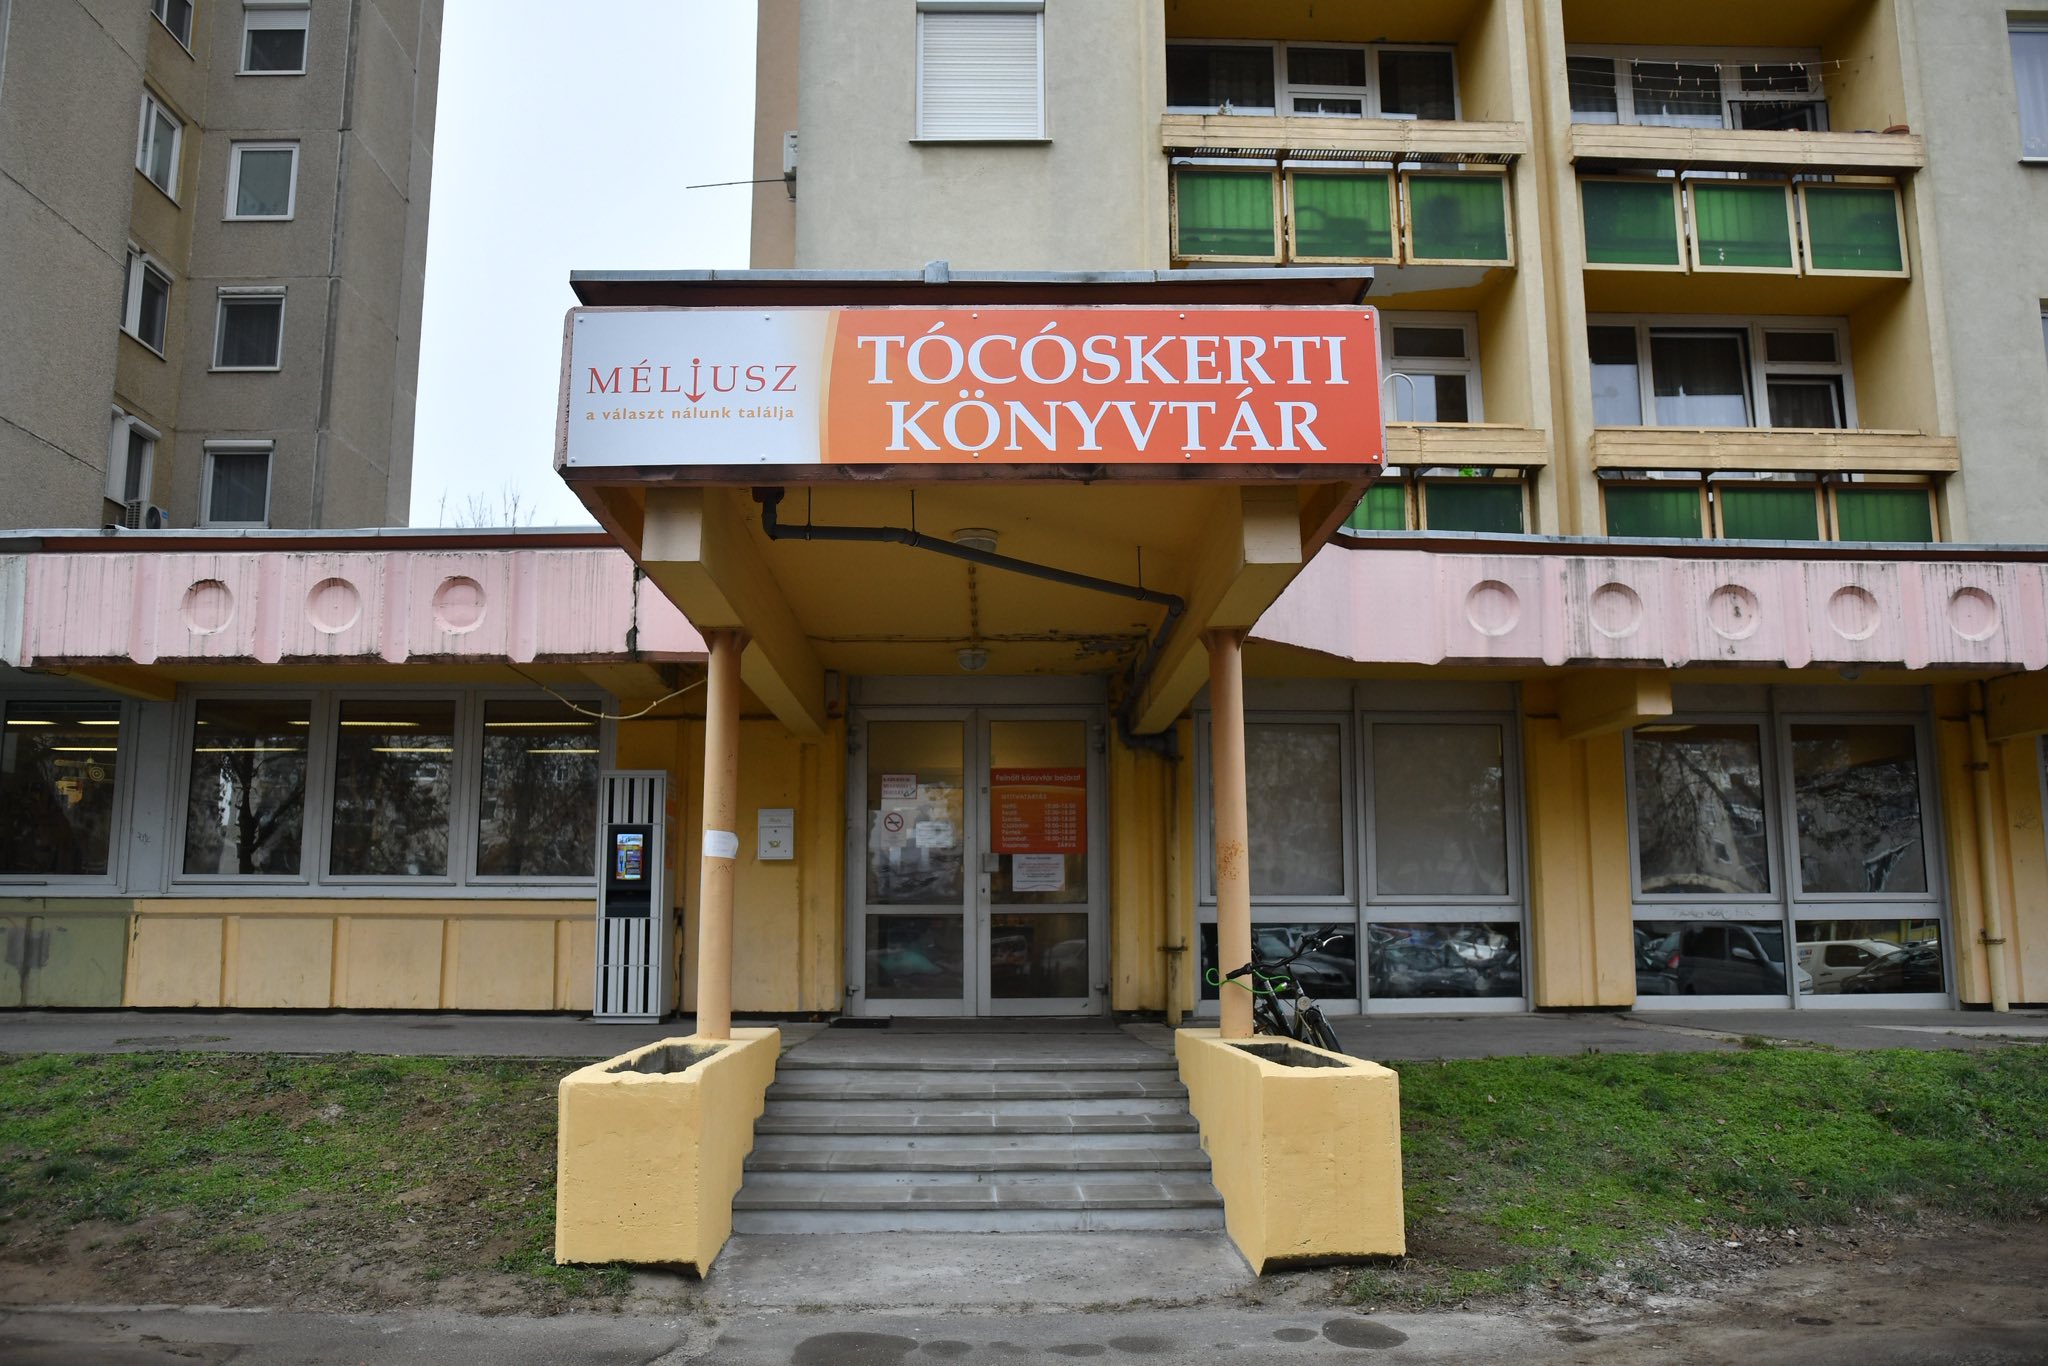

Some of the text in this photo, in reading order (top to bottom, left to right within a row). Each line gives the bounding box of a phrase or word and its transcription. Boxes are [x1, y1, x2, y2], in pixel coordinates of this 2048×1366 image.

[857, 321, 1349, 385] TÓCÓSKERTI
[586, 406, 795, 421] a választ nálunk találja
[885, 387, 1327, 451] KÖNYVTÁR
